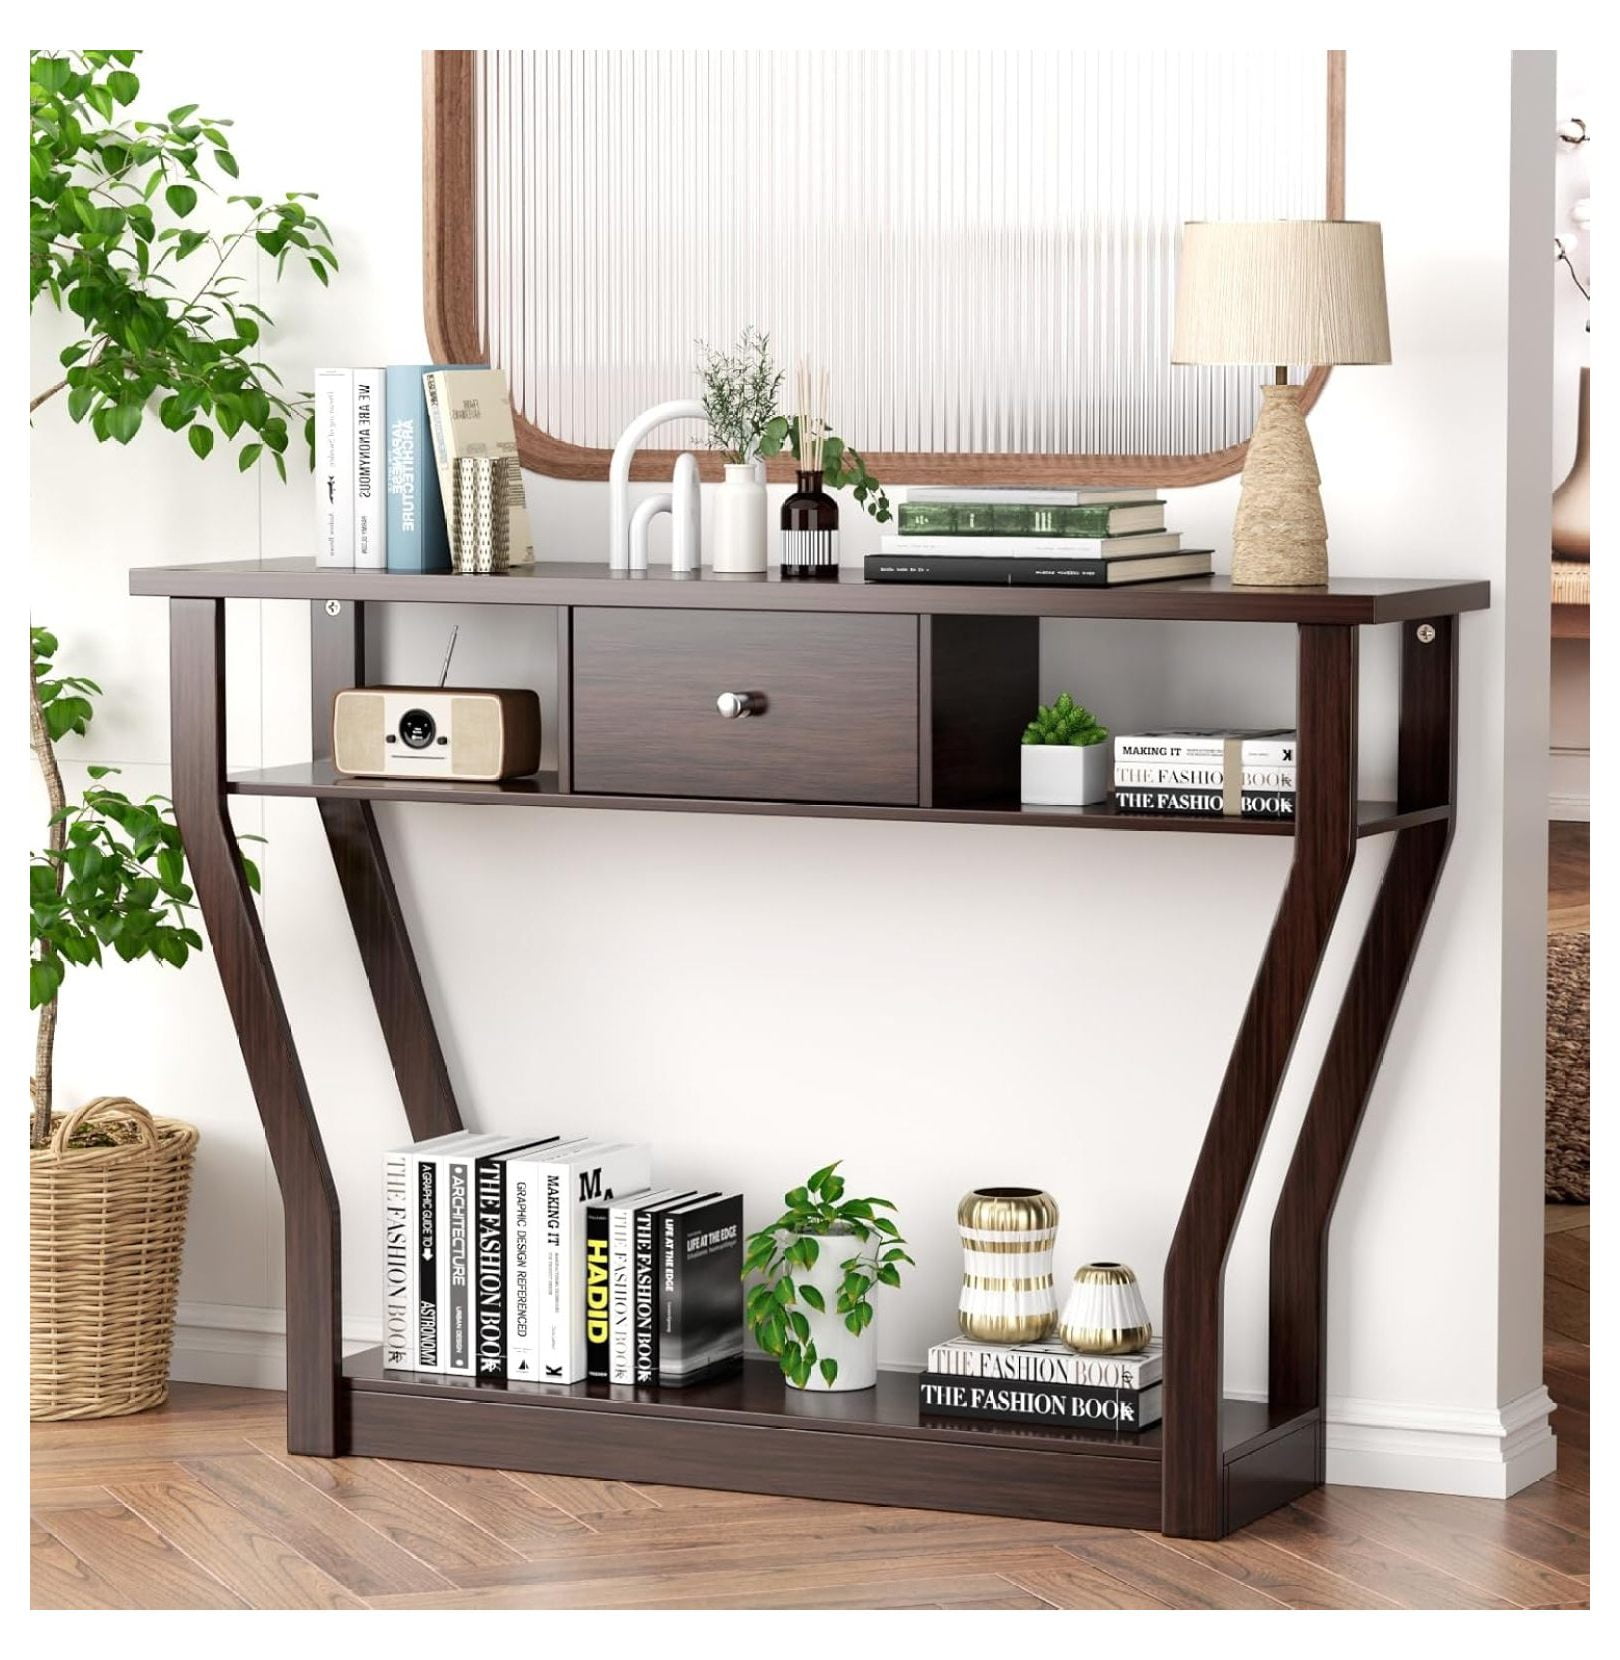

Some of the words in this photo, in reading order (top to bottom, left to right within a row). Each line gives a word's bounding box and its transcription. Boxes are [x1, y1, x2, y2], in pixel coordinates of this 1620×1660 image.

[1122, 746, 1167, 756] MAKING
[1170, 747, 1182, 756] IT
[1116, 767, 1154, 783] THE
[1158, 769, 1223, 786] FASHIO
[1241, 771, 1293, 788] BOOK
[1115, 792, 1154, 808] THE
[1157, 793, 1223, 811] FASHIO
[1241, 796, 1294, 813] BOOK
[386, 1157, 407, 1200] THE
[422, 1164, 433, 1172] A
[479, 1163, 501, 1208] THE
[422, 1172, 433, 1209] GRAPHIC
[516, 1181, 527, 1227] GRAPHIC
[547, 1175, 560, 1229] MAKING
[422, 1210, 433, 1234] GUIDE
[422, 1236, 433, 1247] TO
[451, 1175, 466, 1287] ARCHITECTURE
[547, 1232, 560, 1247] IT
[636, 1213, 652, 1250] THE
[665, 1218, 675, 1237] LIFE
[386, 1206, 407, 1298] FASHION
[479, 1212, 501, 1307] FASHION
[516, 1230, 527, 1267] DESIGN
[665, 1238, 675, 1249] AT
[665, 1250, 675, 1267] THE
[687, 1237, 700, 1252] LIFE
[587, 1239, 609, 1344] HADID
[613, 1252, 628, 1326] FASHION
[636, 1253, 652, 1329] FASHION
[665, 1268, 675, 1292] EDGE
[516, 1270, 527, 1337] REFERENCED
[386, 1304, 407, 1364] BOOK
[420, 1300, 436, 1365] ASTRONOMY
[479, 1311, 502, 1372] BOOK
[636, 1332, 652, 1382] BOOK
[931, 1349, 975, 1377] THE
[979, 1352, 1070, 1383] FASHION
[1074, 1360, 1134, 1390] BOOK
[921, 1384, 967, 1408] THE
[971, 1388, 1066, 1416] FASHION
[1071, 1397, 1135, 1422] BOOK
